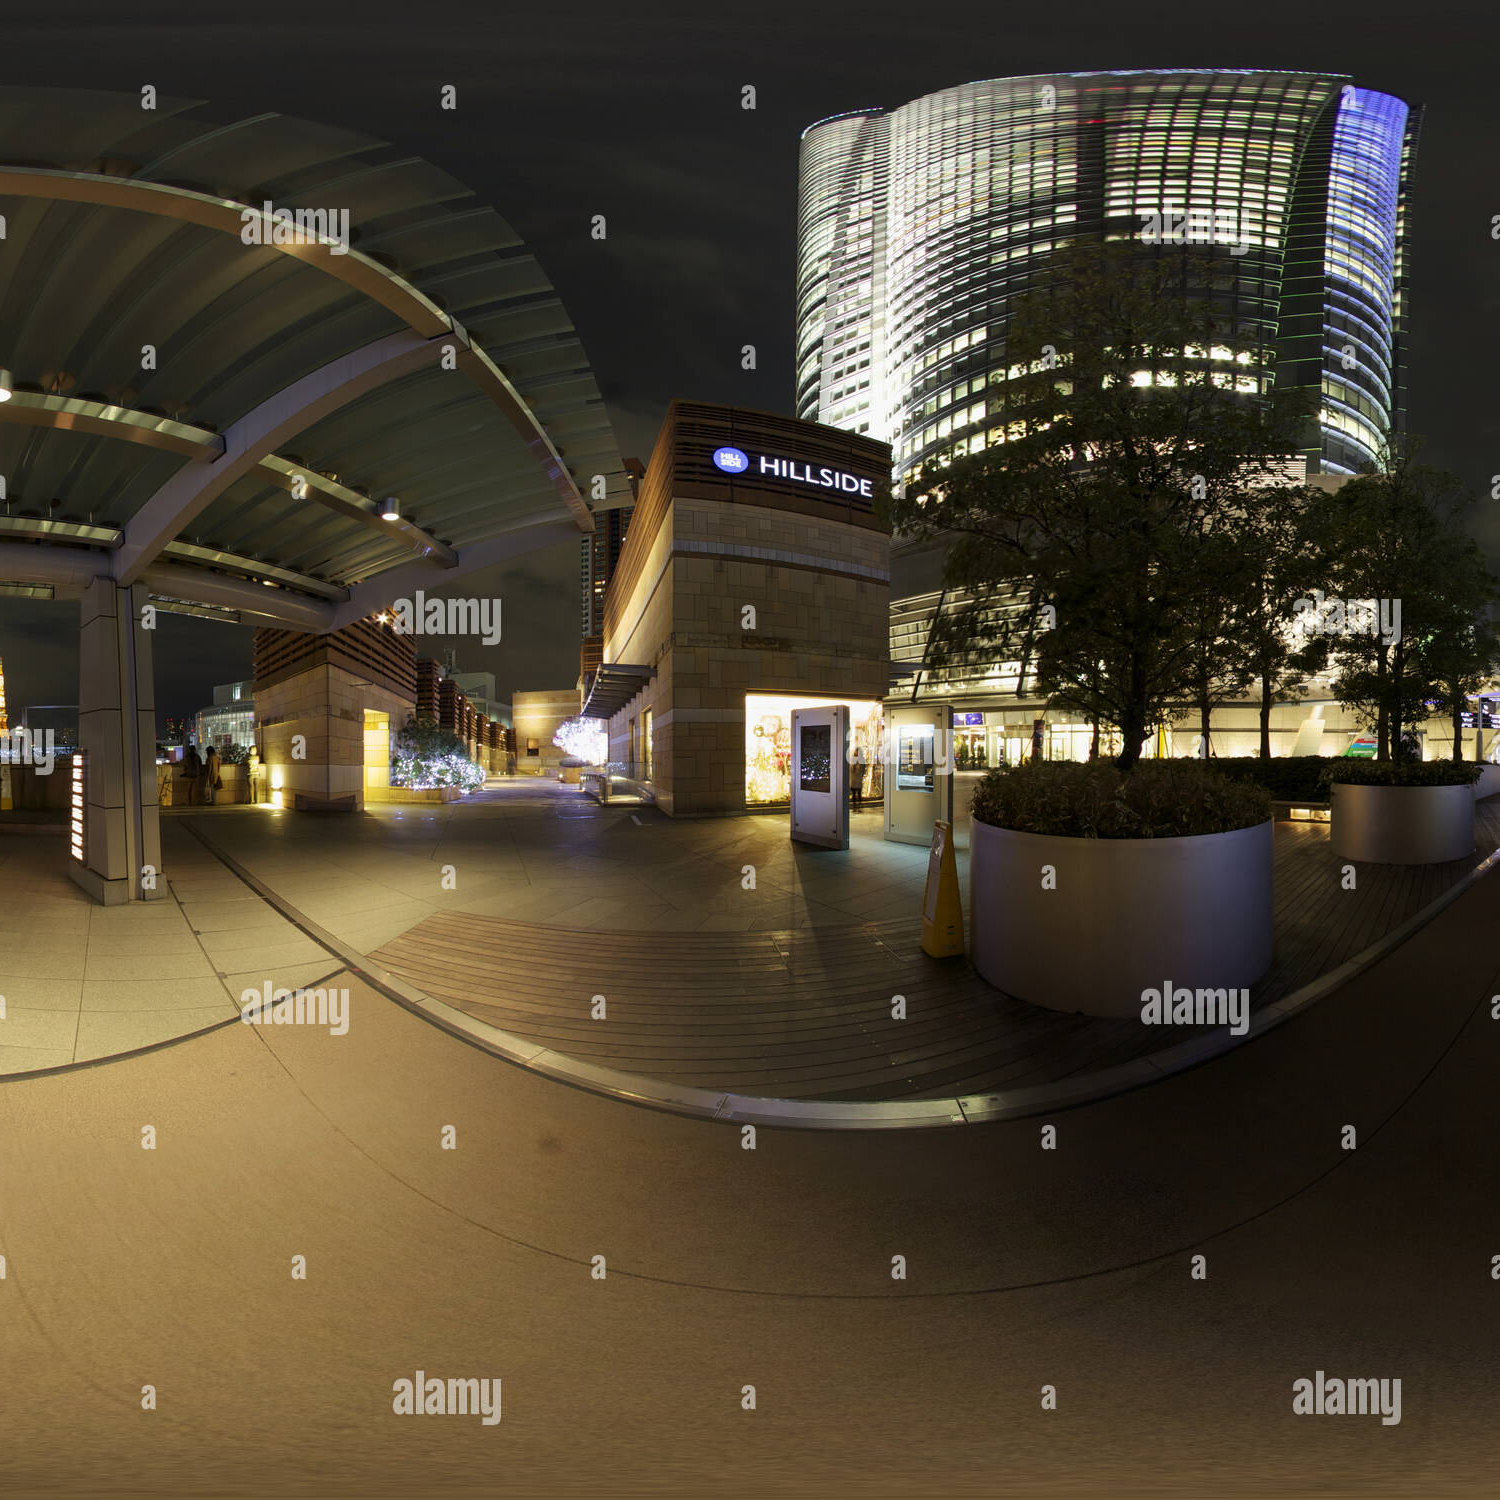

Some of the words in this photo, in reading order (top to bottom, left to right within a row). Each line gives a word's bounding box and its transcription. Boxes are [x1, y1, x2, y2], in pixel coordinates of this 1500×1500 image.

[720, 452, 739, 461] HILL
[720, 459, 742, 468] SIDE
[760, 456, 873, 497] HILLSIDE
